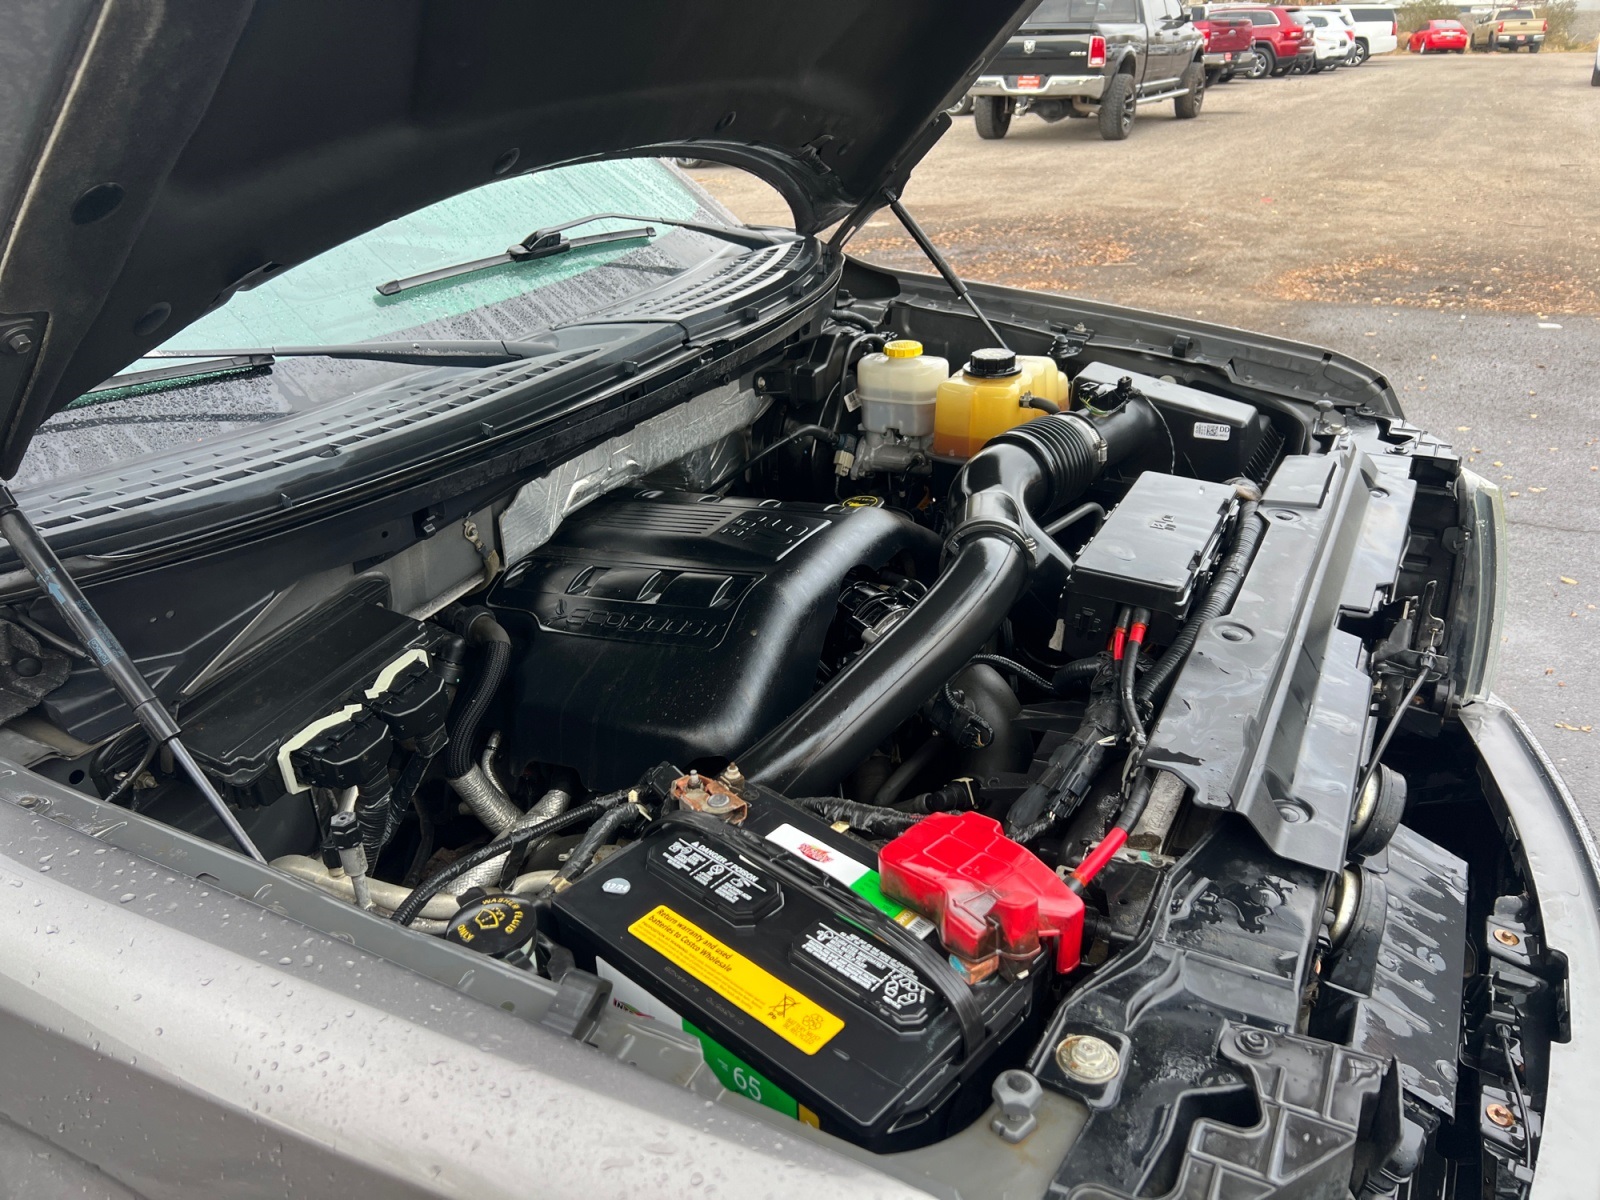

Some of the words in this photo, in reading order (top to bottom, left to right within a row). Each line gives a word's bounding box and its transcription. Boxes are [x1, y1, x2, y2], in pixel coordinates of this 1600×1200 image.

[482, 897, 521, 910] WASHER
[457, 924, 475, 942] ONLY
[505, 910, 524, 935] FLUID
[656, 908, 679, 924] Return
[675, 922, 704, 942] warranty
[702, 939, 717, 950] and
[715, 947, 733, 960] used
[648, 915, 676, 934] batteries
[680, 936, 702, 951] Costco
[699, 949, 733, 972] Wholesale
[767, 1011, 778, 1021] Pb
[733, 1066, 763, 1102] 65
